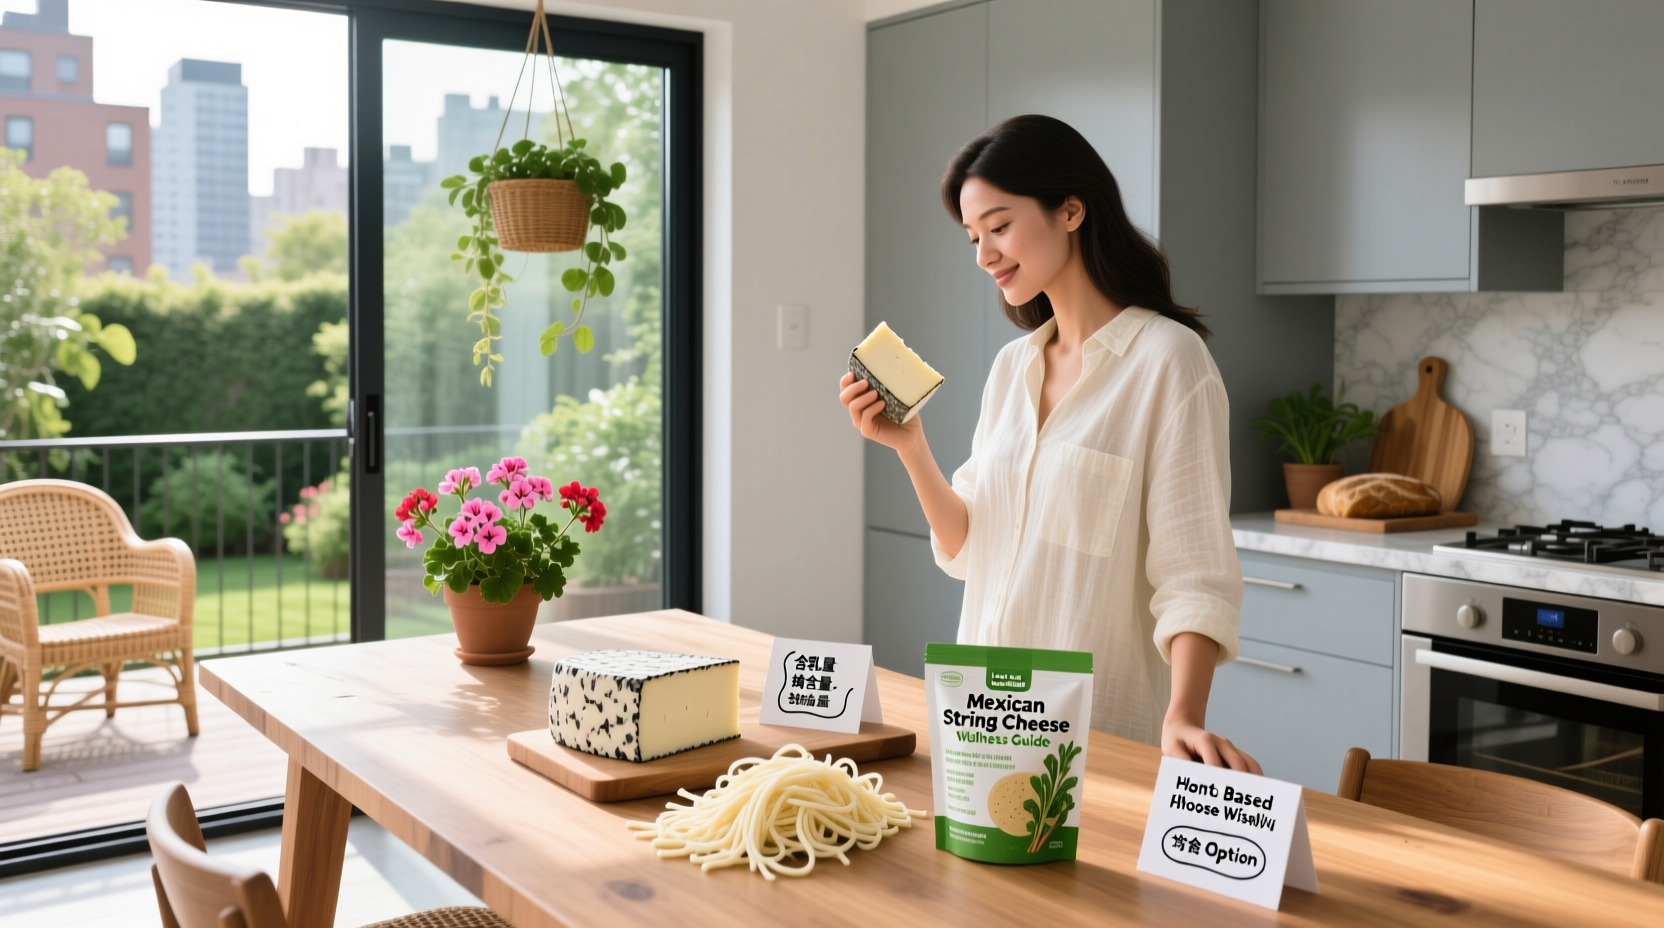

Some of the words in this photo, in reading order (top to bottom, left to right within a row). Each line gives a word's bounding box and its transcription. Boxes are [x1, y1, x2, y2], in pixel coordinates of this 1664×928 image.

[966, 693, 1045, 714] Mexican
[943, 709, 998, 733] String
[1001, 714, 1070, 733] Cheese
[1011, 733, 1051, 748] Guide
[1223, 785, 1274, 811] Based
[1204, 841, 1258, 868] Option
